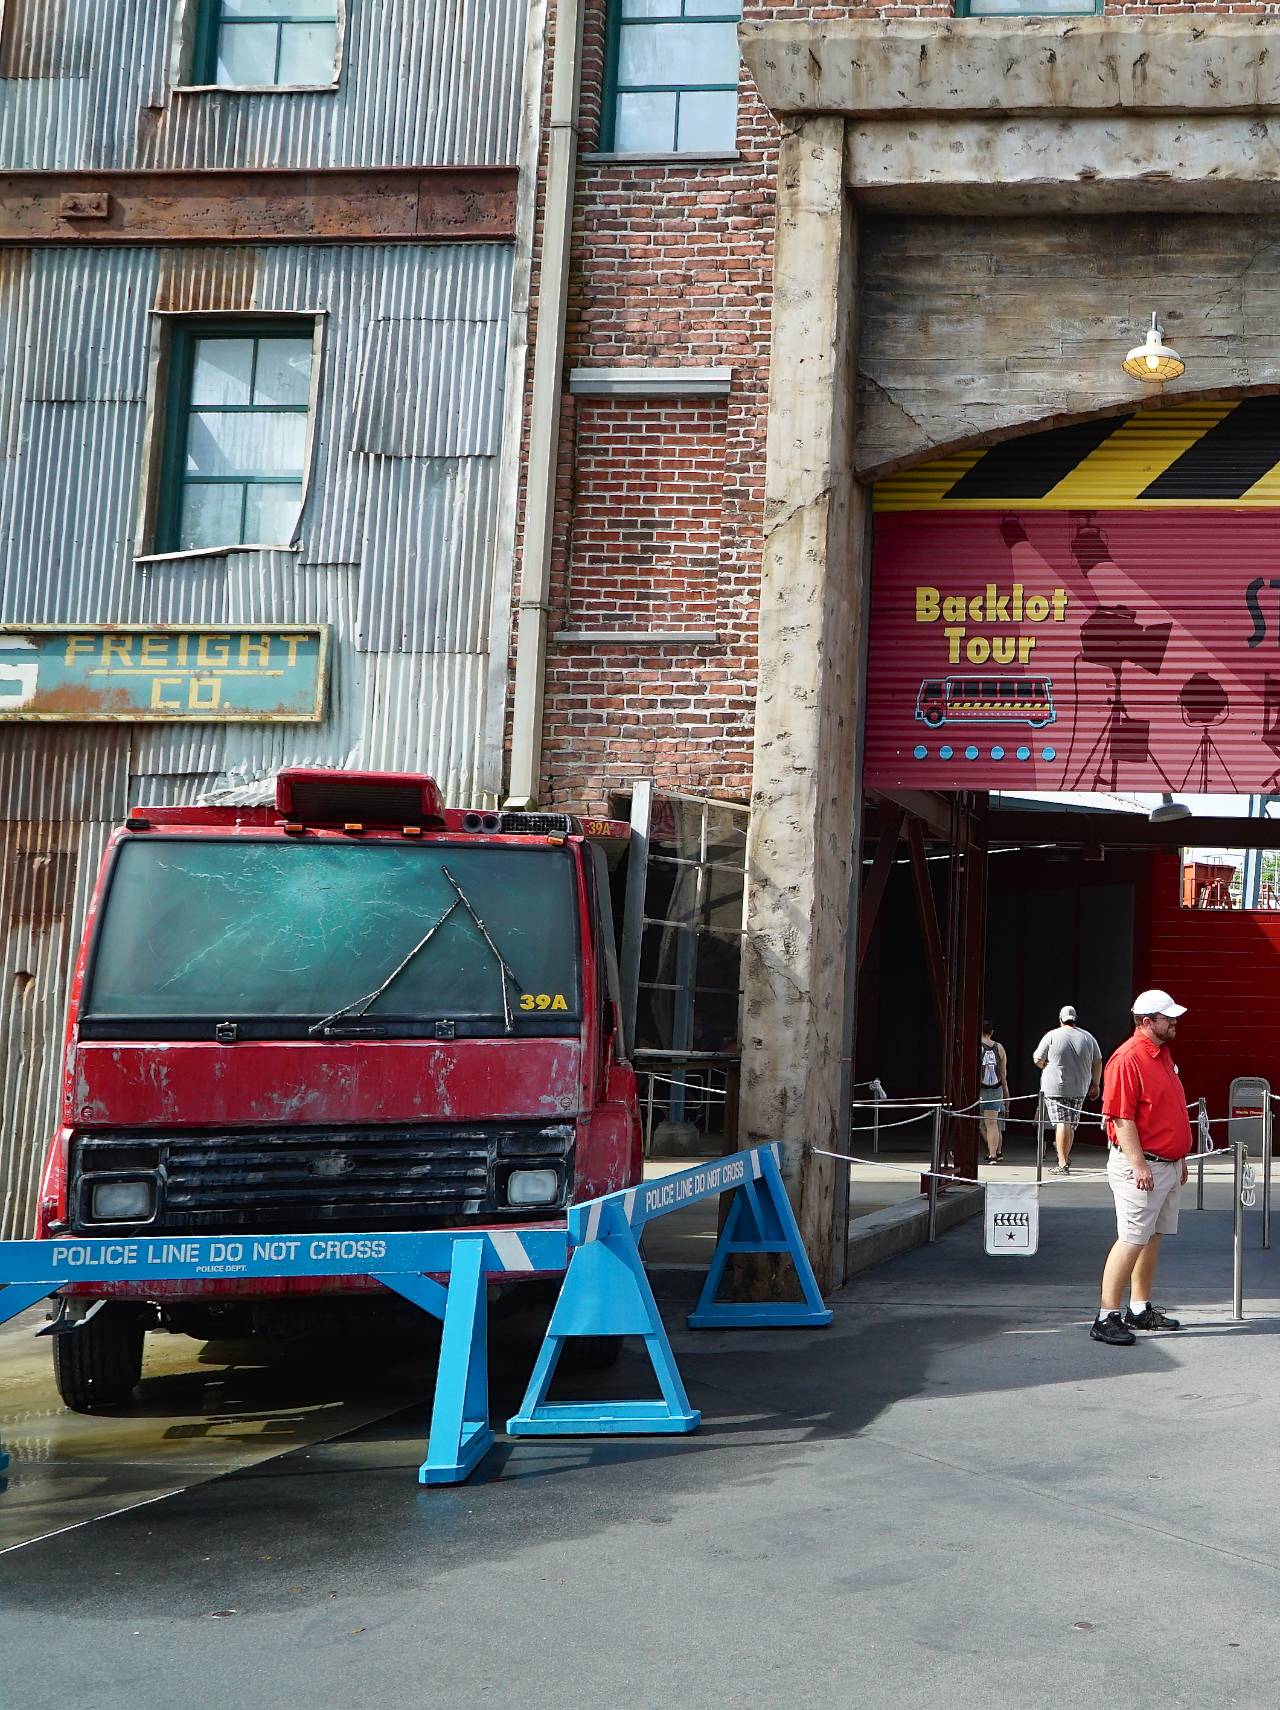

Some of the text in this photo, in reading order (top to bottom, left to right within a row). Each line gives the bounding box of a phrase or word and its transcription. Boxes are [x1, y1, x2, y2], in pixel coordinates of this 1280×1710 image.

[915, 583, 1068, 622] Backlot
[64, 634, 309, 667] FREIGHT
[944, 627, 1037, 664] Tour
[151, 678, 231, 709] CO.
[588, 821, 610, 835] 39A
[519, 994, 568, 1010] 39A
[645, 1160, 744, 1213] POLICE LINE DO NOT CROSS
[52, 1240, 386, 1267] POLICE LINE DO NOT CROSS
[196, 1265, 224, 1273] POLICE
